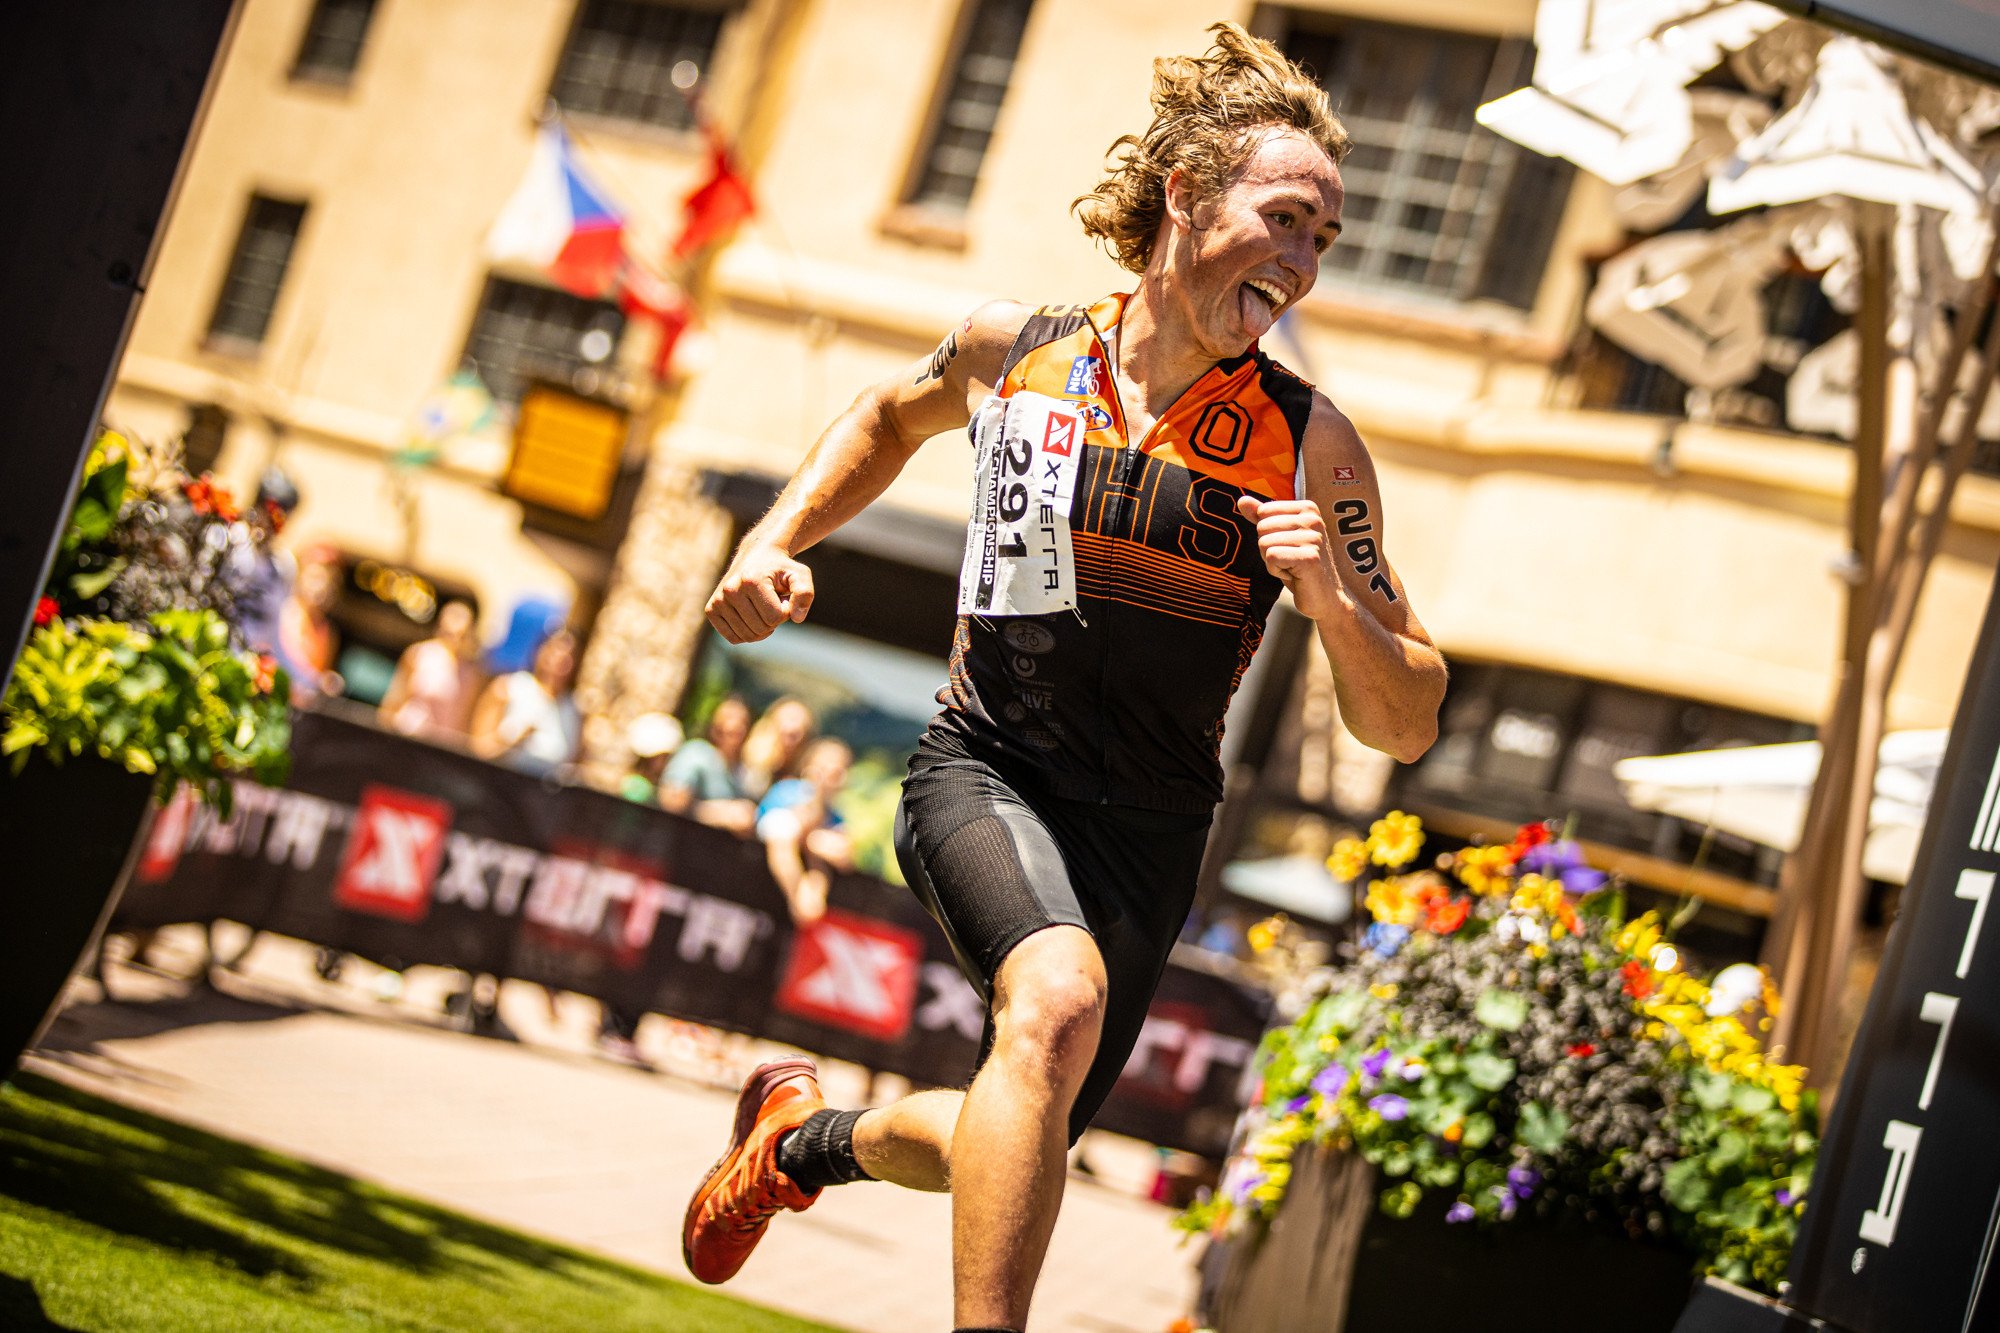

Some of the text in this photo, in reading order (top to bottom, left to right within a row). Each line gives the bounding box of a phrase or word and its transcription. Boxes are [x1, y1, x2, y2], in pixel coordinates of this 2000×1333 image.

[1067, 358, 1086, 393] NICA
[981, 455, 999, 585] CHAMPIONSHIP
[997, 438, 1033, 558] 291
[1040, 458, 1062, 590] XTERRA
[1332, 498, 1398, 604] 291
